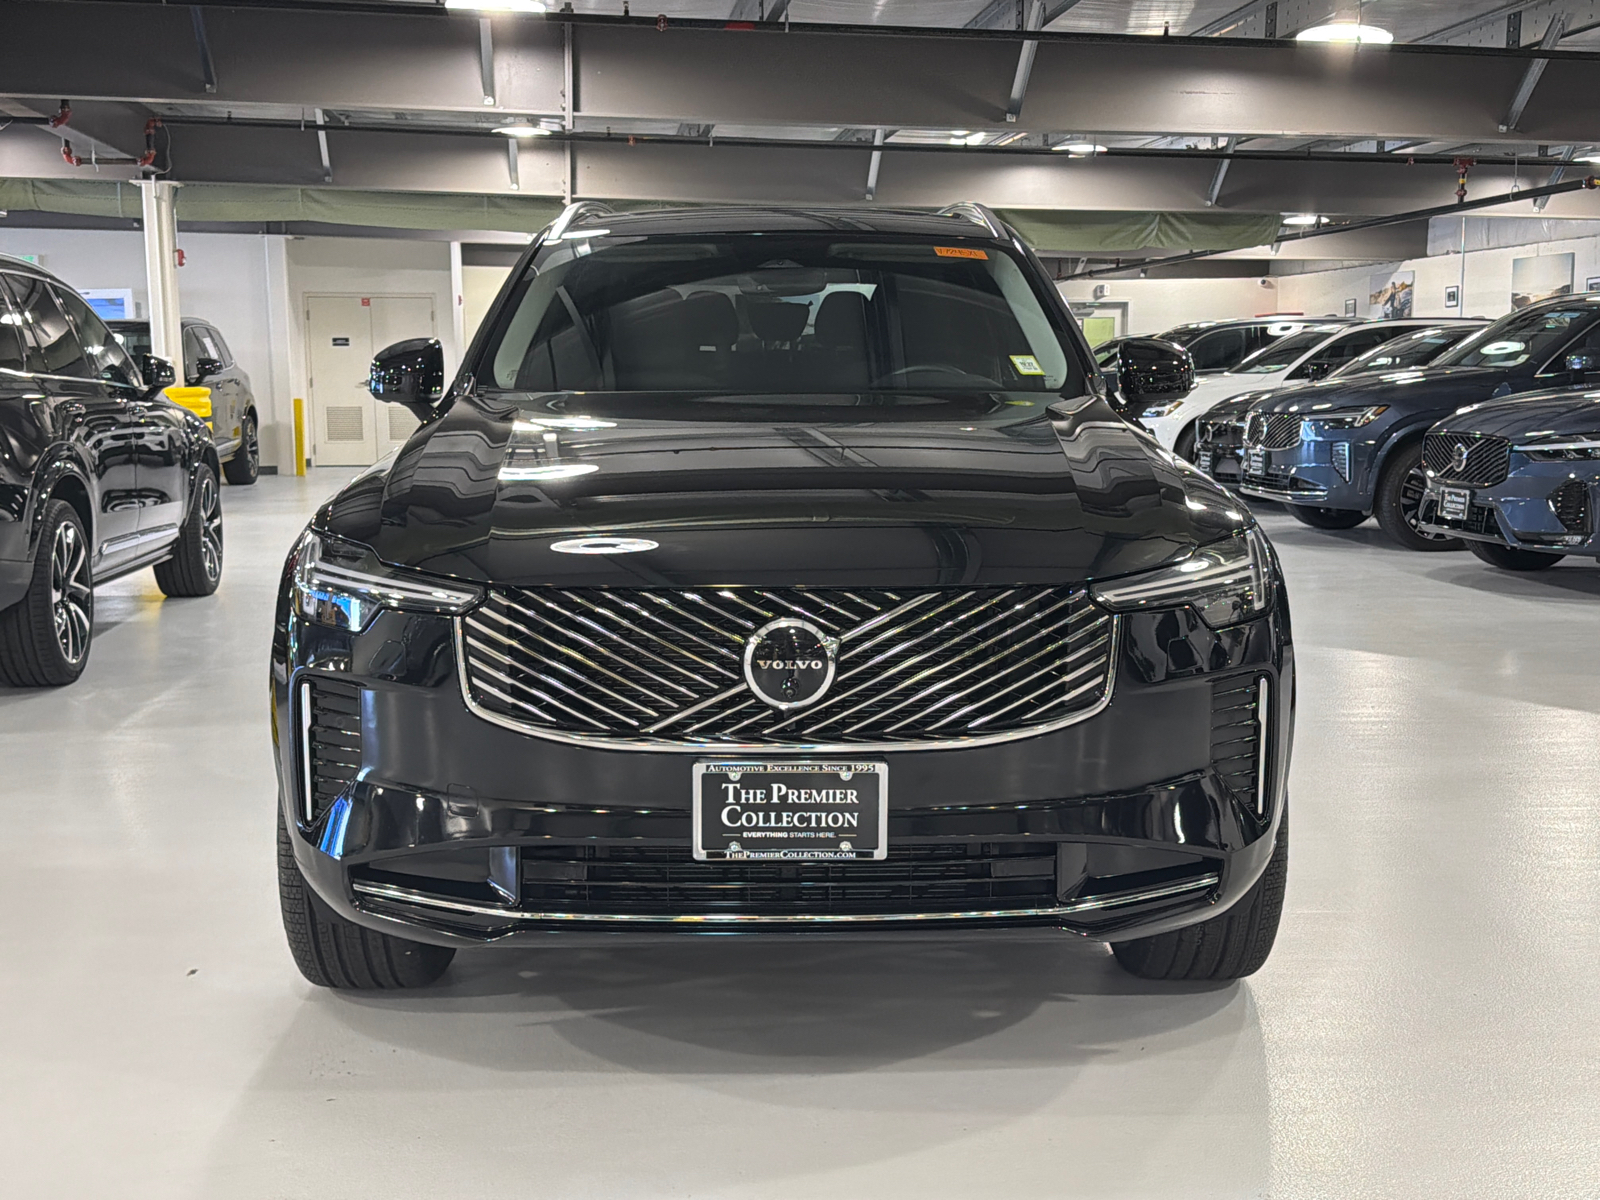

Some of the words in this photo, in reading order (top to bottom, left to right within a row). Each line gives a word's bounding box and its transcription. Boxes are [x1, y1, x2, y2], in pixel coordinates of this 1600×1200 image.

[757, 660, 823, 670] VOLVO
[851, 764, 874, 772] 1995
[721, 783, 767, 804] THE
[770, 783, 859, 804] PREMIER
[721, 805, 859, 828] COLLECTION
